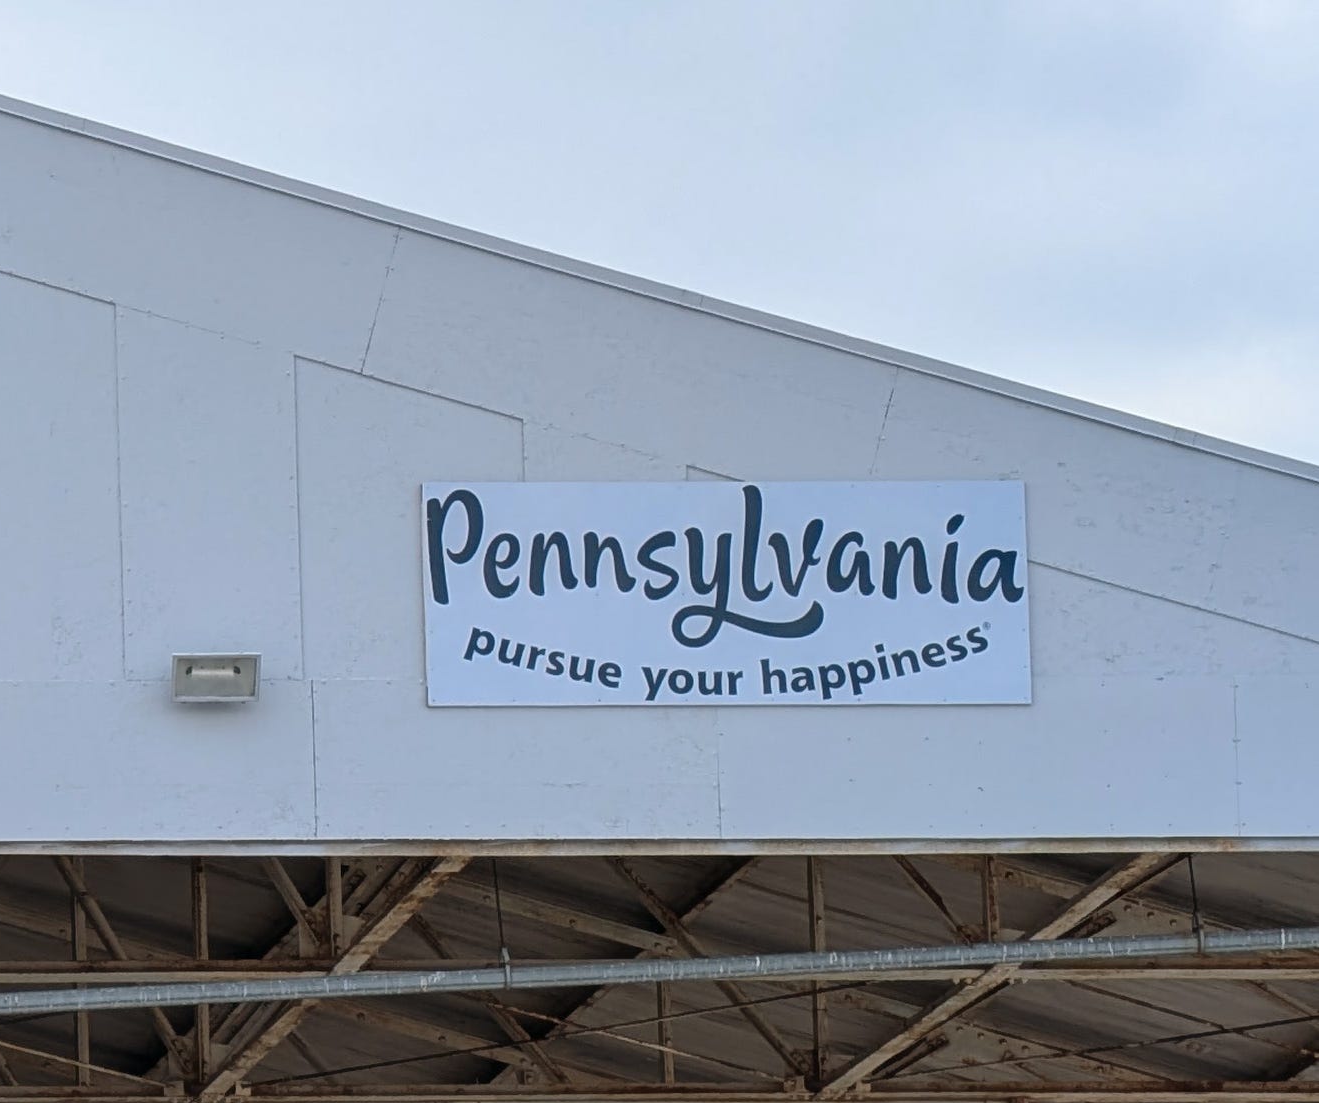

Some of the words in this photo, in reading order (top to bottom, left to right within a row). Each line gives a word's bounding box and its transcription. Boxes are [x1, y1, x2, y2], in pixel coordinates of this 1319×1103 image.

[425, 484, 1025, 648] Pennsylvania
[462, 626, 623, 689] pursue
[641, 666, 745, 701] your
